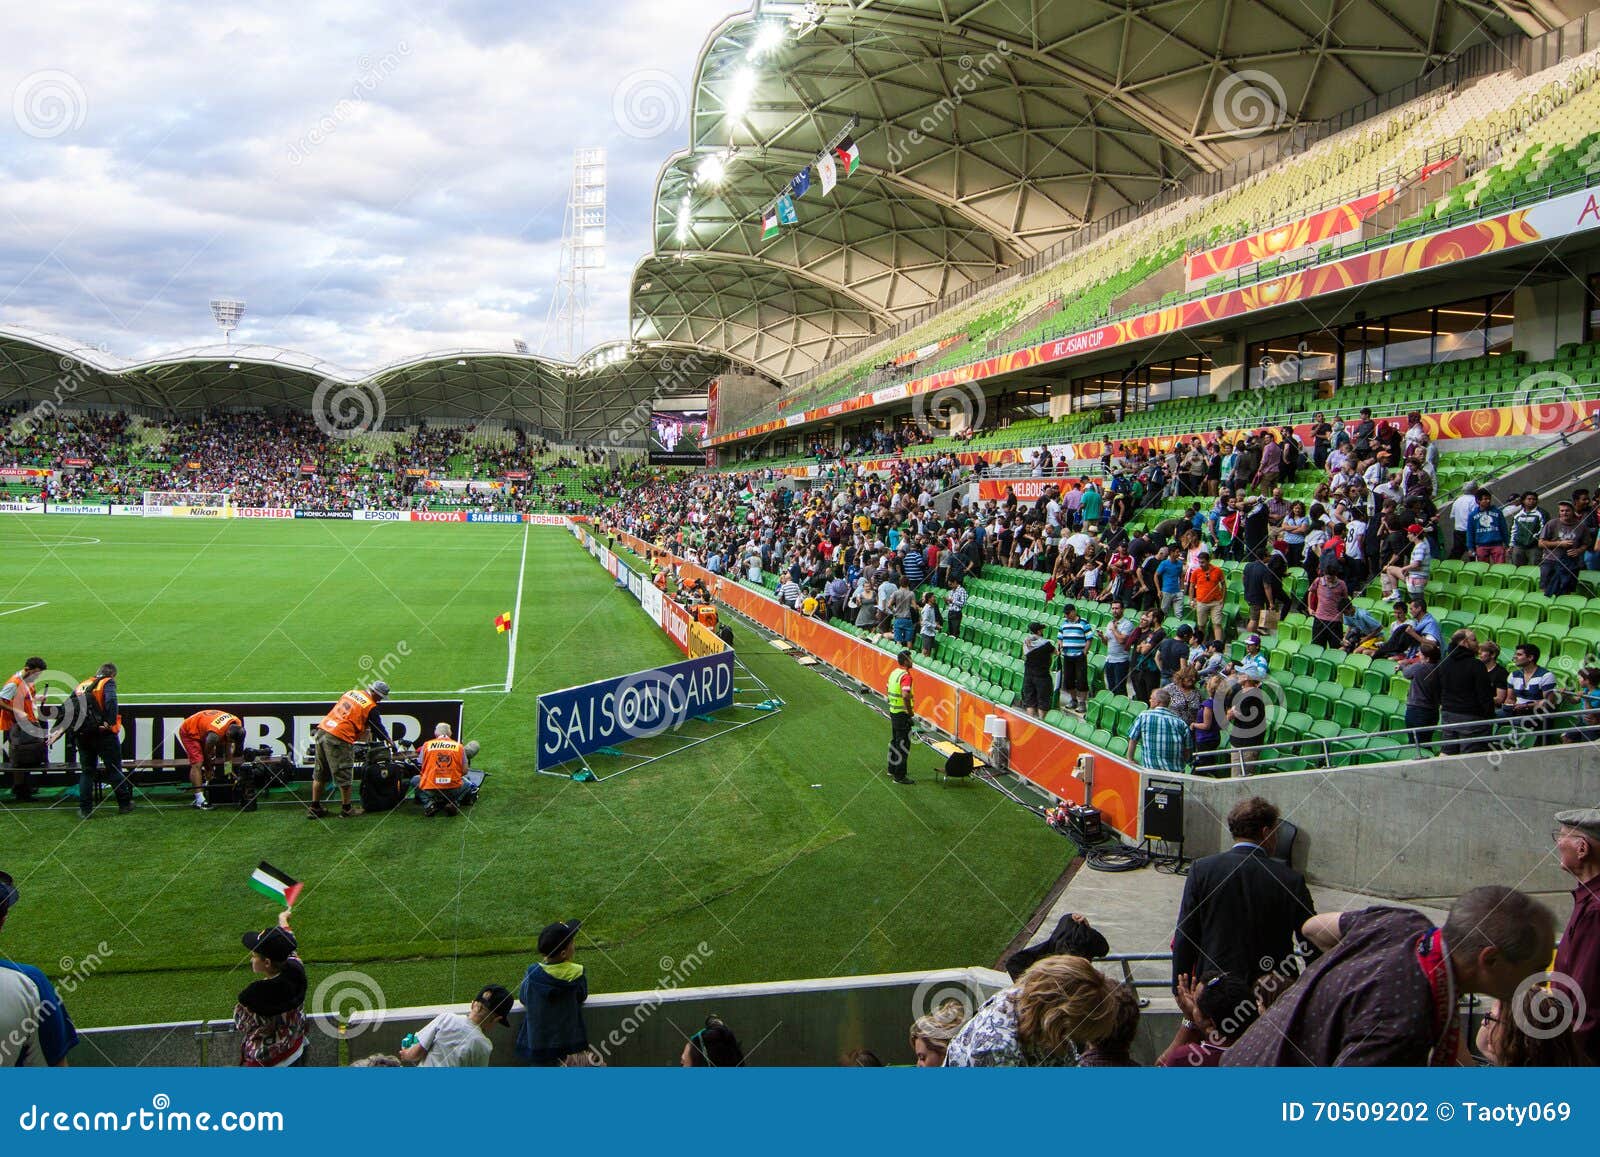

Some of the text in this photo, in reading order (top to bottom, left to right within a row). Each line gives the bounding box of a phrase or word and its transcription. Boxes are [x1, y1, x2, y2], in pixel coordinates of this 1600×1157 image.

[1052, 330, 1104, 357] AFC ASIAN CUP
[1011, 482, 1058, 497] MELBOU
[55, 505, 101, 514] FamilyMart
[190, 508, 218, 516] Nikon
[236, 508, 293, 518] TOSHIBA
[365, 511, 400, 520] EPSON
[417, 512, 461, 521] TOYOTA
[471, 513, 518, 523] SAMSUNG
[532, 515, 565, 525] TOSHIBA
[544, 663, 731, 754] SAISON CARD
[430, 741, 457, 750] Nikon
